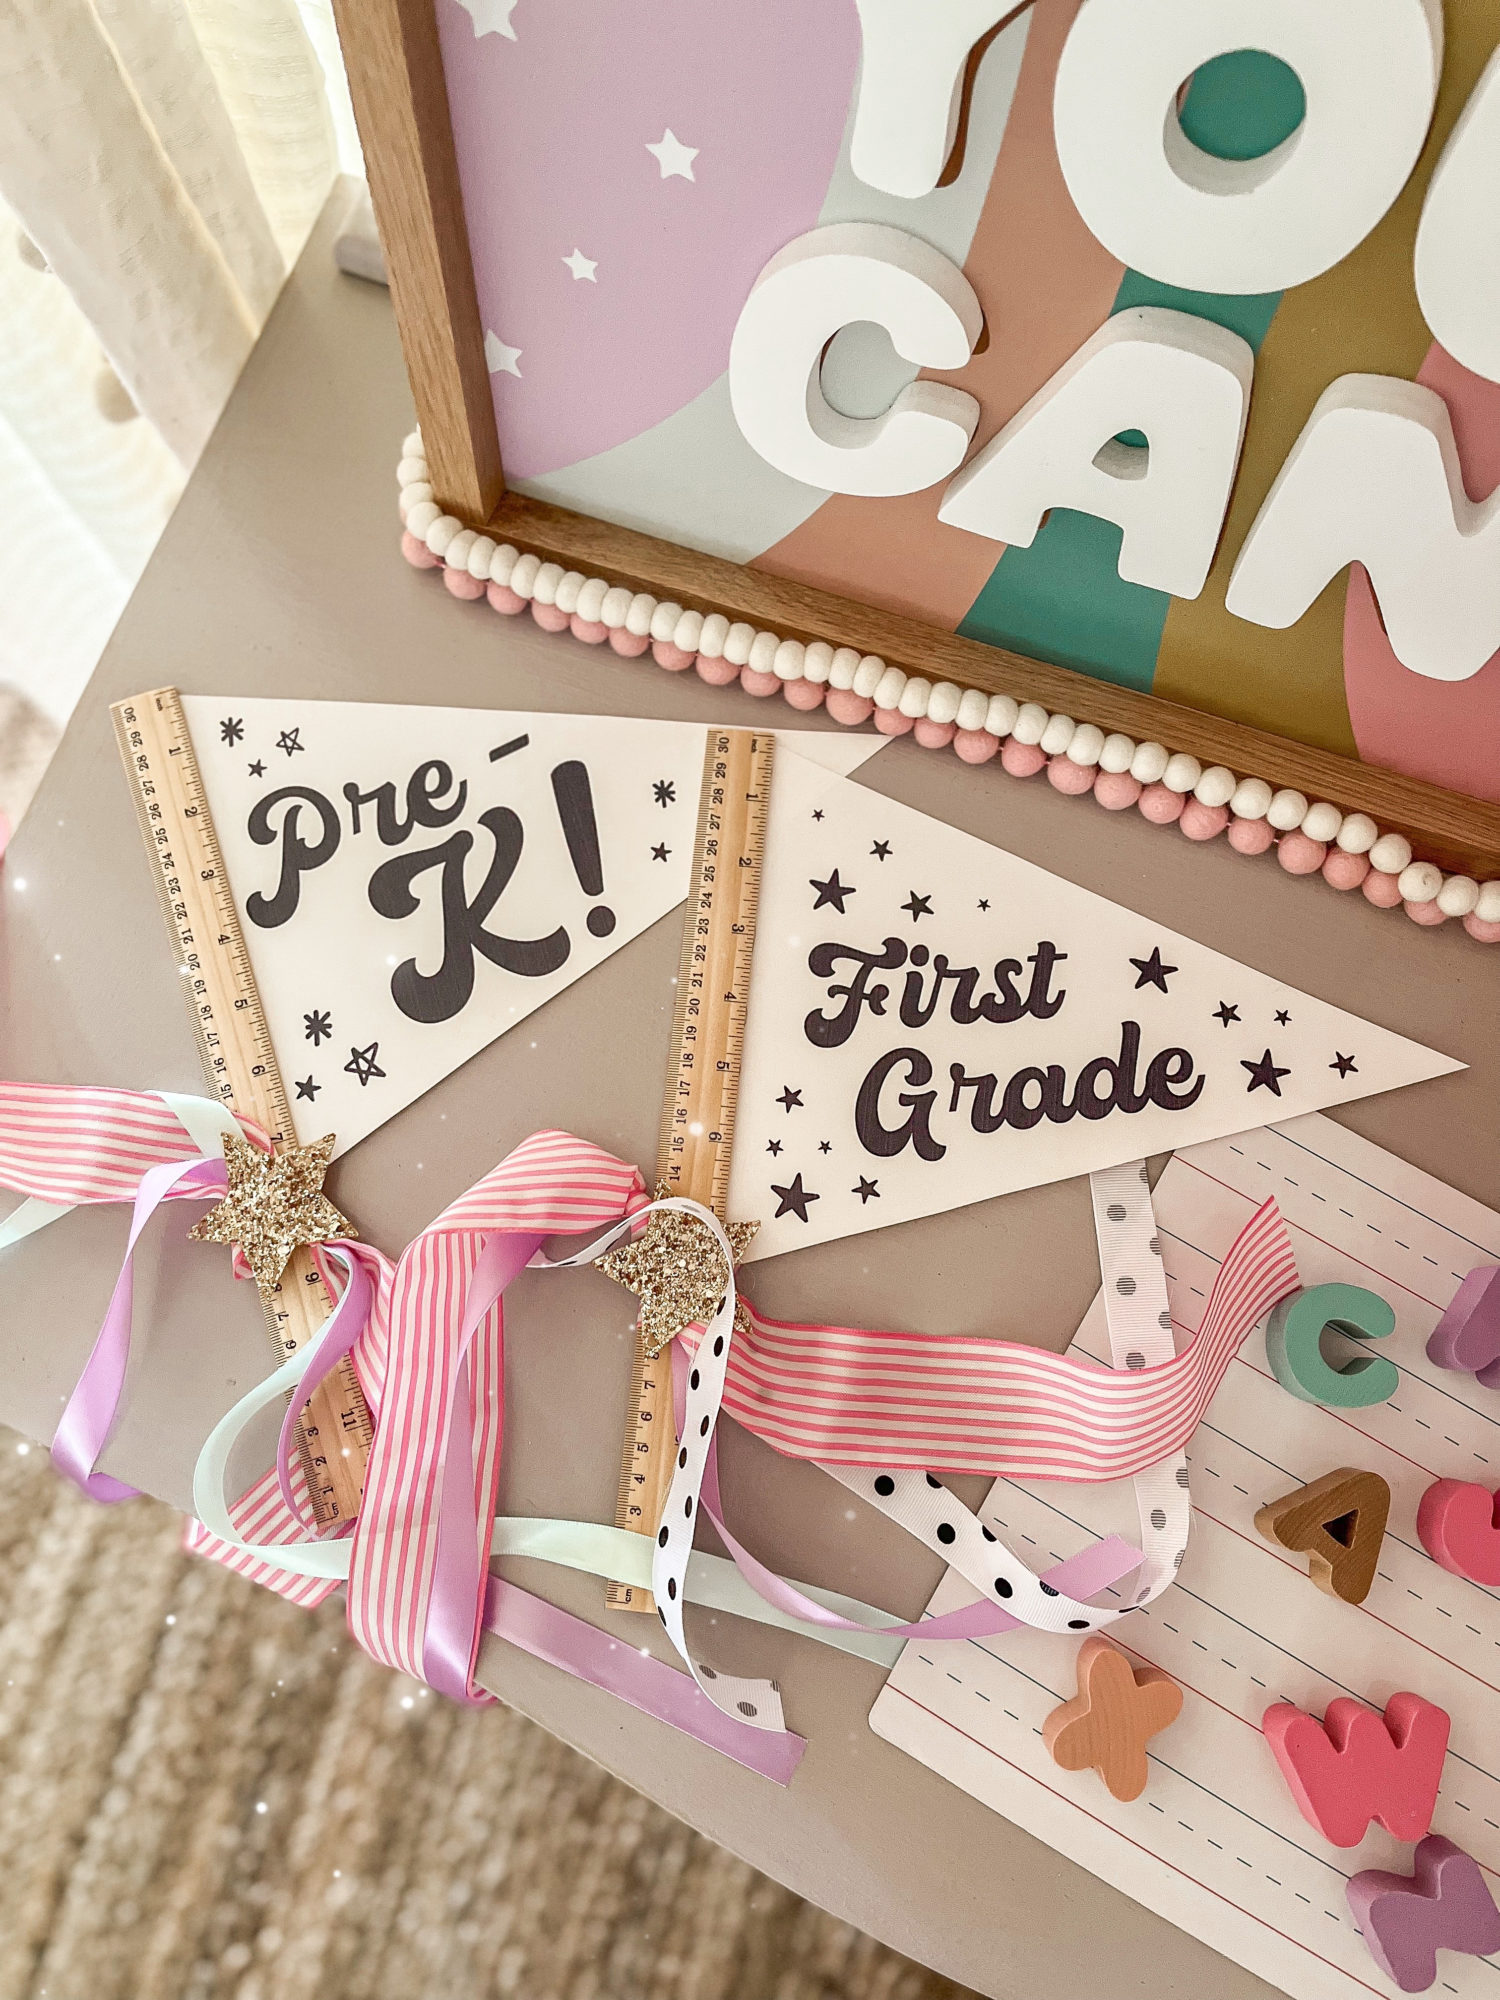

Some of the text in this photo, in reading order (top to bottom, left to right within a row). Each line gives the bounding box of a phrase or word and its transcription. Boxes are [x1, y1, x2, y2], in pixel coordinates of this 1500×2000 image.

[729, 222, 1500, 682] CAN
[124, 707, 137, 724] 30
[130, 730, 143, 748] 29
[136, 754, 149, 772] 28
[143, 780, 155, 796] 27
[746, 792, 758, 802] 1
[150, 803, 162, 820] 26
[156, 827, 169, 845] 25
[164, 852, 175, 870] 24
[739, 857, 752, 868] 2
[168, 877, 181, 895] 23
[368, 760, 616, 1024] K!
[176, 902, 188, 920] 22
[182, 928, 194, 944] 21
[732, 923, 745, 933] 3
[188, 953, 201, 971] 20
[194, 979, 207, 996] 19
[804, 937, 1067, 1048] First
[724, 991, 738, 1001] 4
[200, 1005, 214, 1021] 18
[206, 1032, 220, 1047] 17
[155, 697, 163, 712] inch
[168, 746, 181, 756] 1
[184, 806, 198, 818] 2
[200, 870, 215, 879] 3
[218, 934, 230, 944] 4
[234, 999, 249, 1009] 5
[251, 1065, 266, 1076] 6
[340, 1410, 357, 1428] 11
[213, 1058, 227, 1074] 16
[716, 1060, 730, 1070] 5
[220, 1084, 234, 1100] 15
[855, 1021, 1205, 1161] Grade
[708, 1131, 722, 1142] 6
[624, 736, 730, 1603] cm 3 4 5 6 7 14 15 16 17 18 19 20 21 22 23 24 25 26 27 28 29 30
[278, 1312, 289, 1322] 7
[285, 1339, 297, 1350] 6
[1266, 1282, 1400, 1408] C
[307, 1426, 319, 1438] 3
[314, 1456, 327, 1467] 2
[322, 1484, 334, 1496] 1
[331, 1502, 339, 1516] cm
[1254, 1467, 1391, 1606] A
